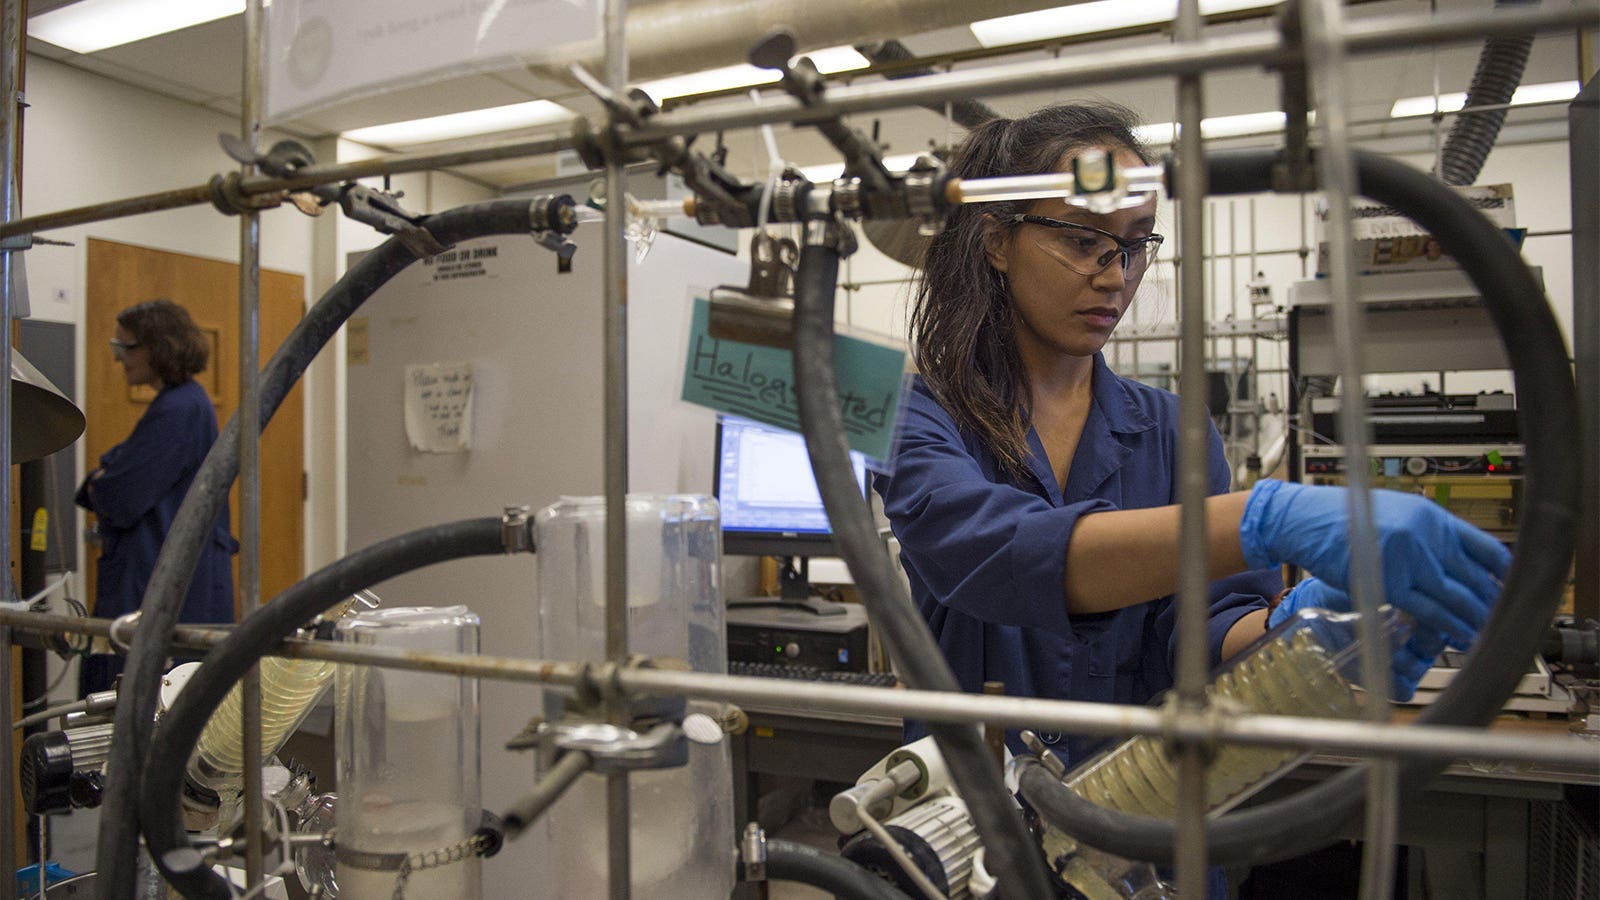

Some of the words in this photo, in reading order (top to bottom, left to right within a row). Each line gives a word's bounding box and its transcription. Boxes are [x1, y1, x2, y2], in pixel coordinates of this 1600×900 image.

[436, 251, 457, 262] FOOD
[460, 250, 470, 261] OR
[473, 247, 497, 259] DRINK
[695, 335, 892, 426] Halogted
